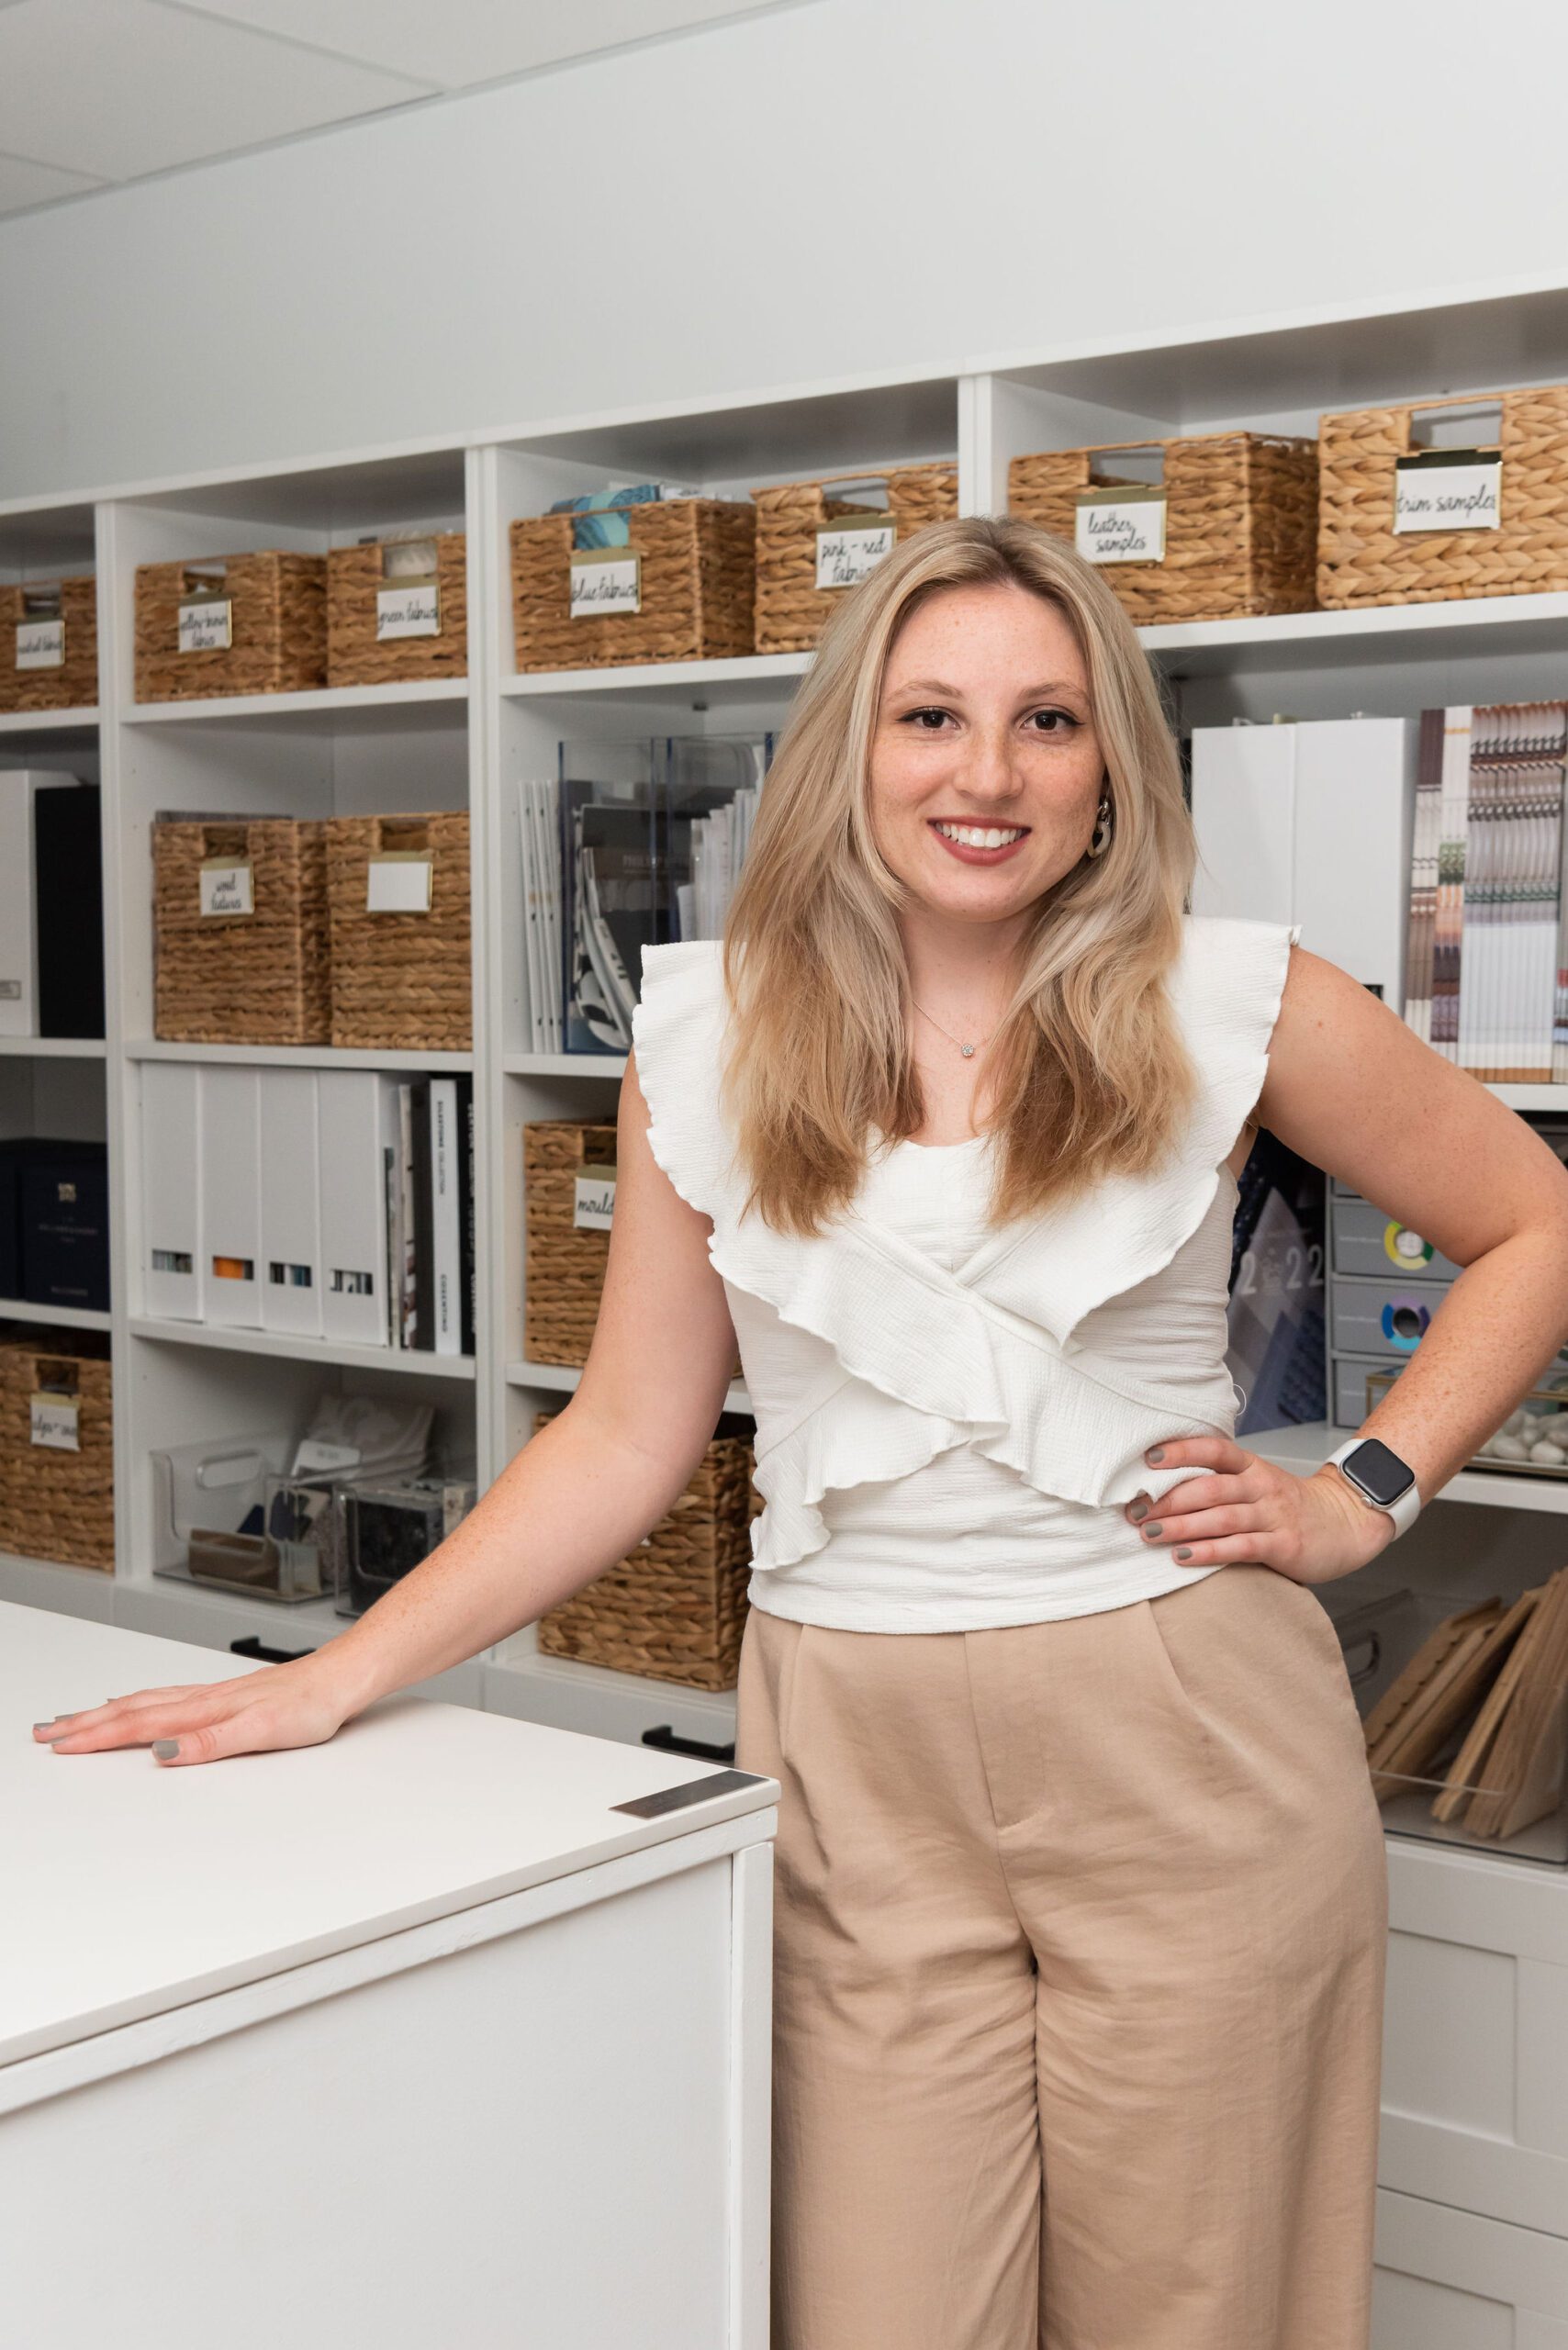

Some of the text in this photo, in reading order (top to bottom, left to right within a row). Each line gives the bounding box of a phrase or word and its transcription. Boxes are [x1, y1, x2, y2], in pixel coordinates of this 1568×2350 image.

[1397, 484, 1496, 518] trim samples
[1088, 511, 1134, 534] leather
[821, 536, 848, 567] pink
[863, 532, 888, 554] red
[1095, 527, 1147, 557] samples
[577, 1192, 614, 1215] mould
